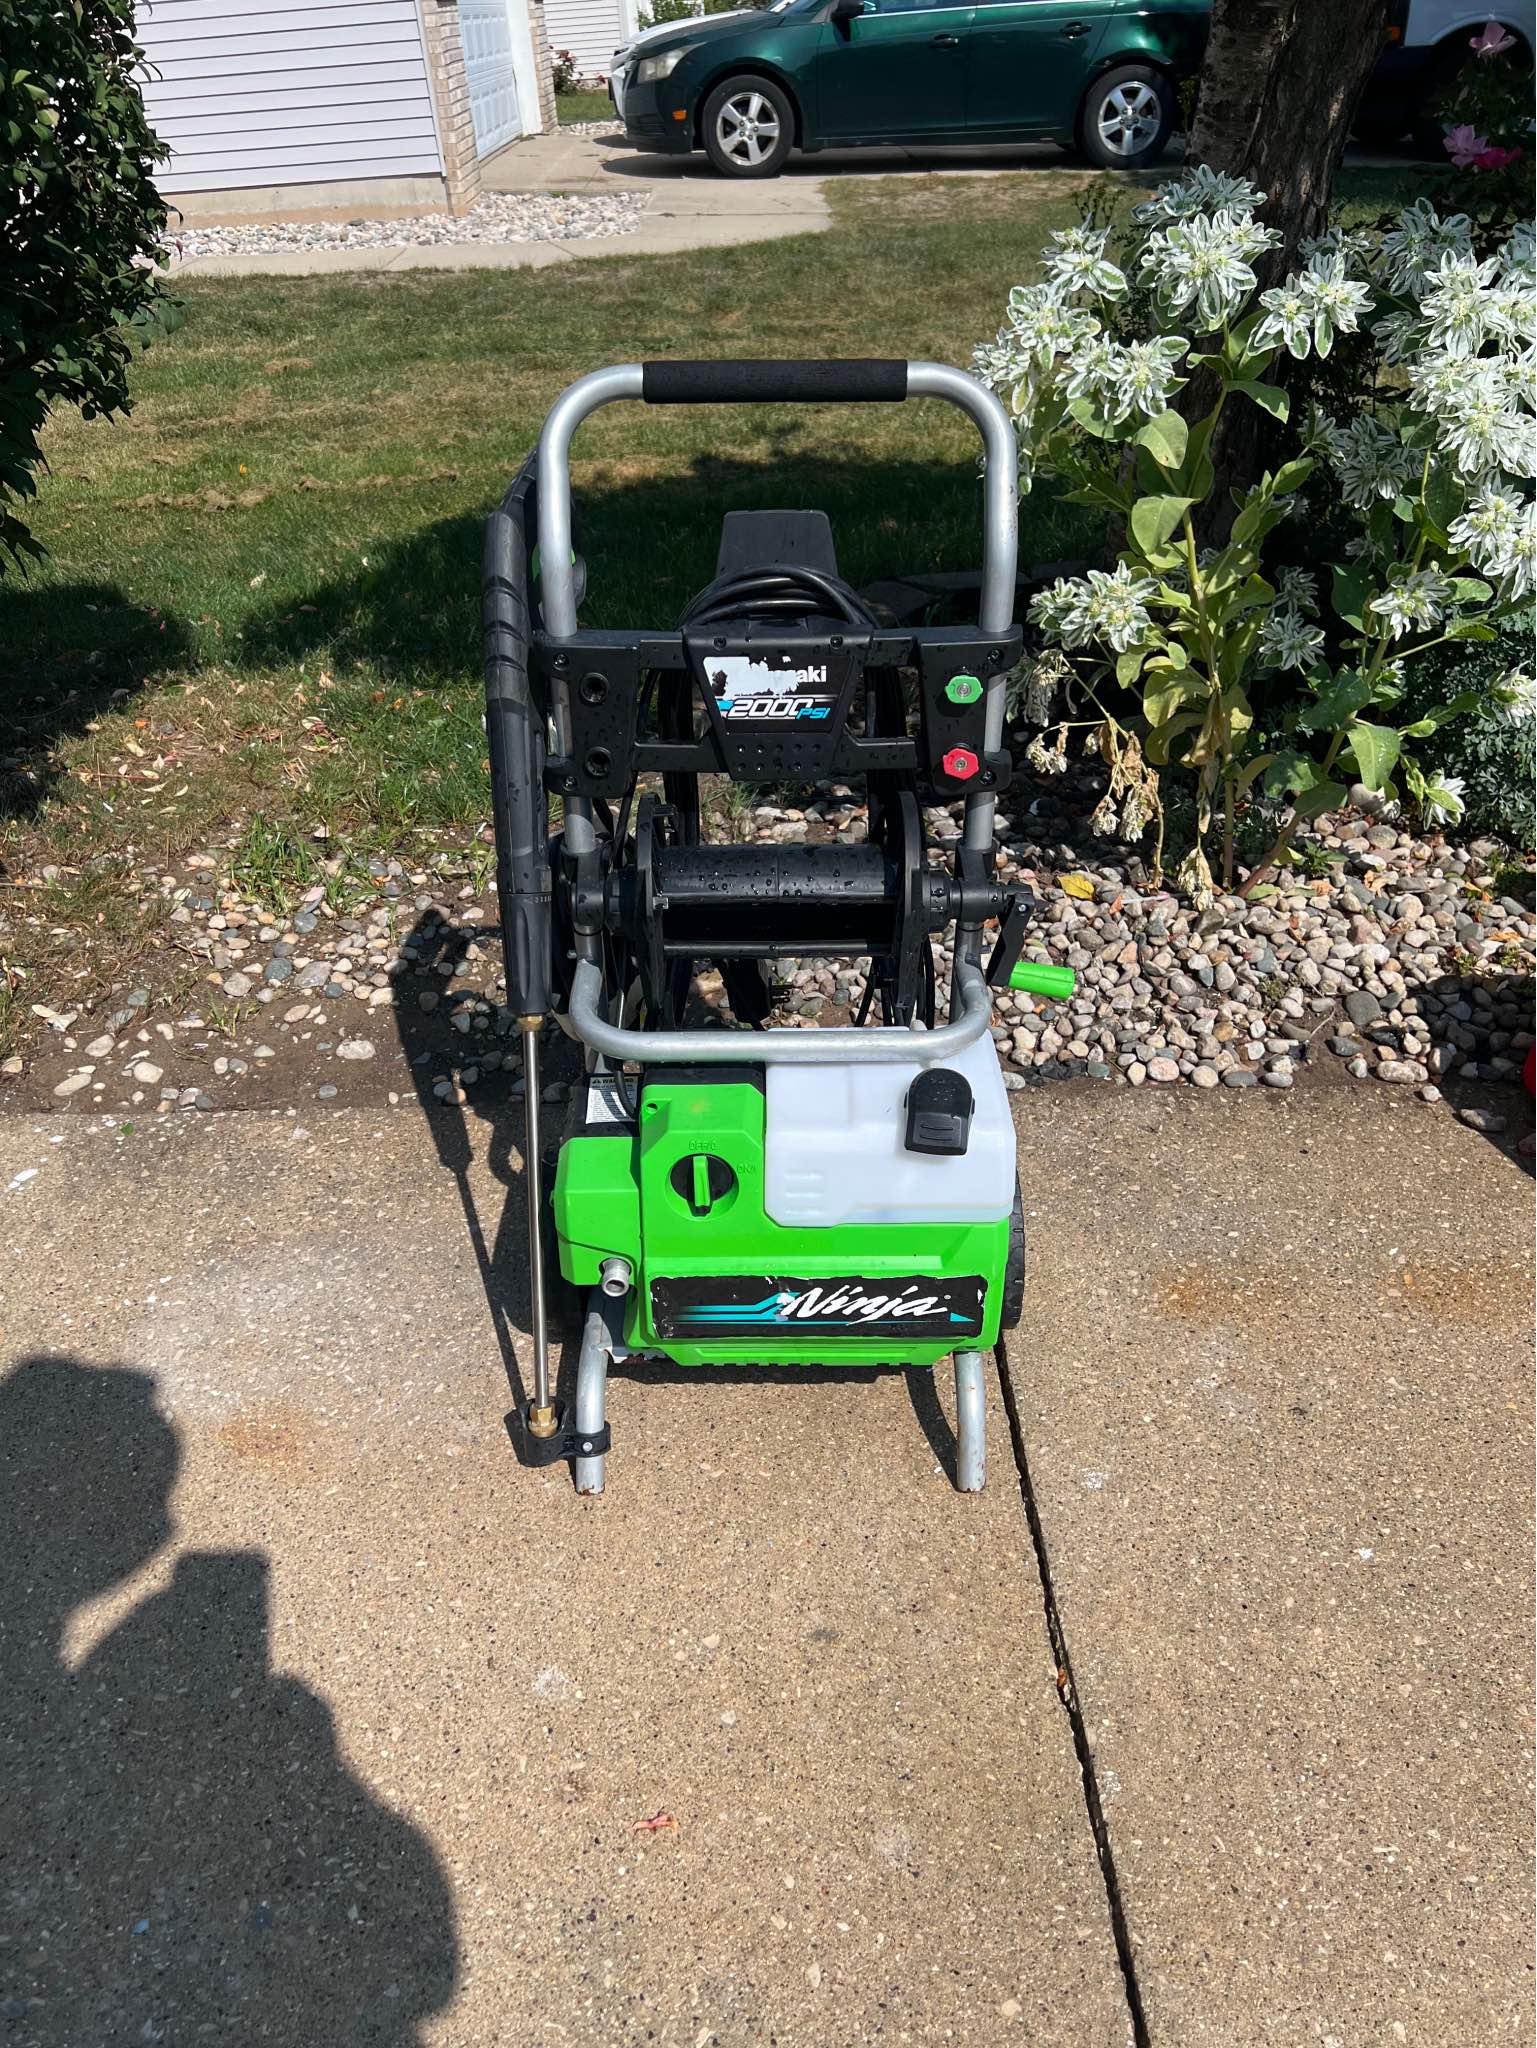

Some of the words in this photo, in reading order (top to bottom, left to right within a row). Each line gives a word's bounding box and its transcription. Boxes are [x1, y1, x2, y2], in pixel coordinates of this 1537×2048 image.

[727, 698, 814, 718] 2000
[796, 707, 830, 719] PSI
[780, 1285, 948, 1326] Ninja
